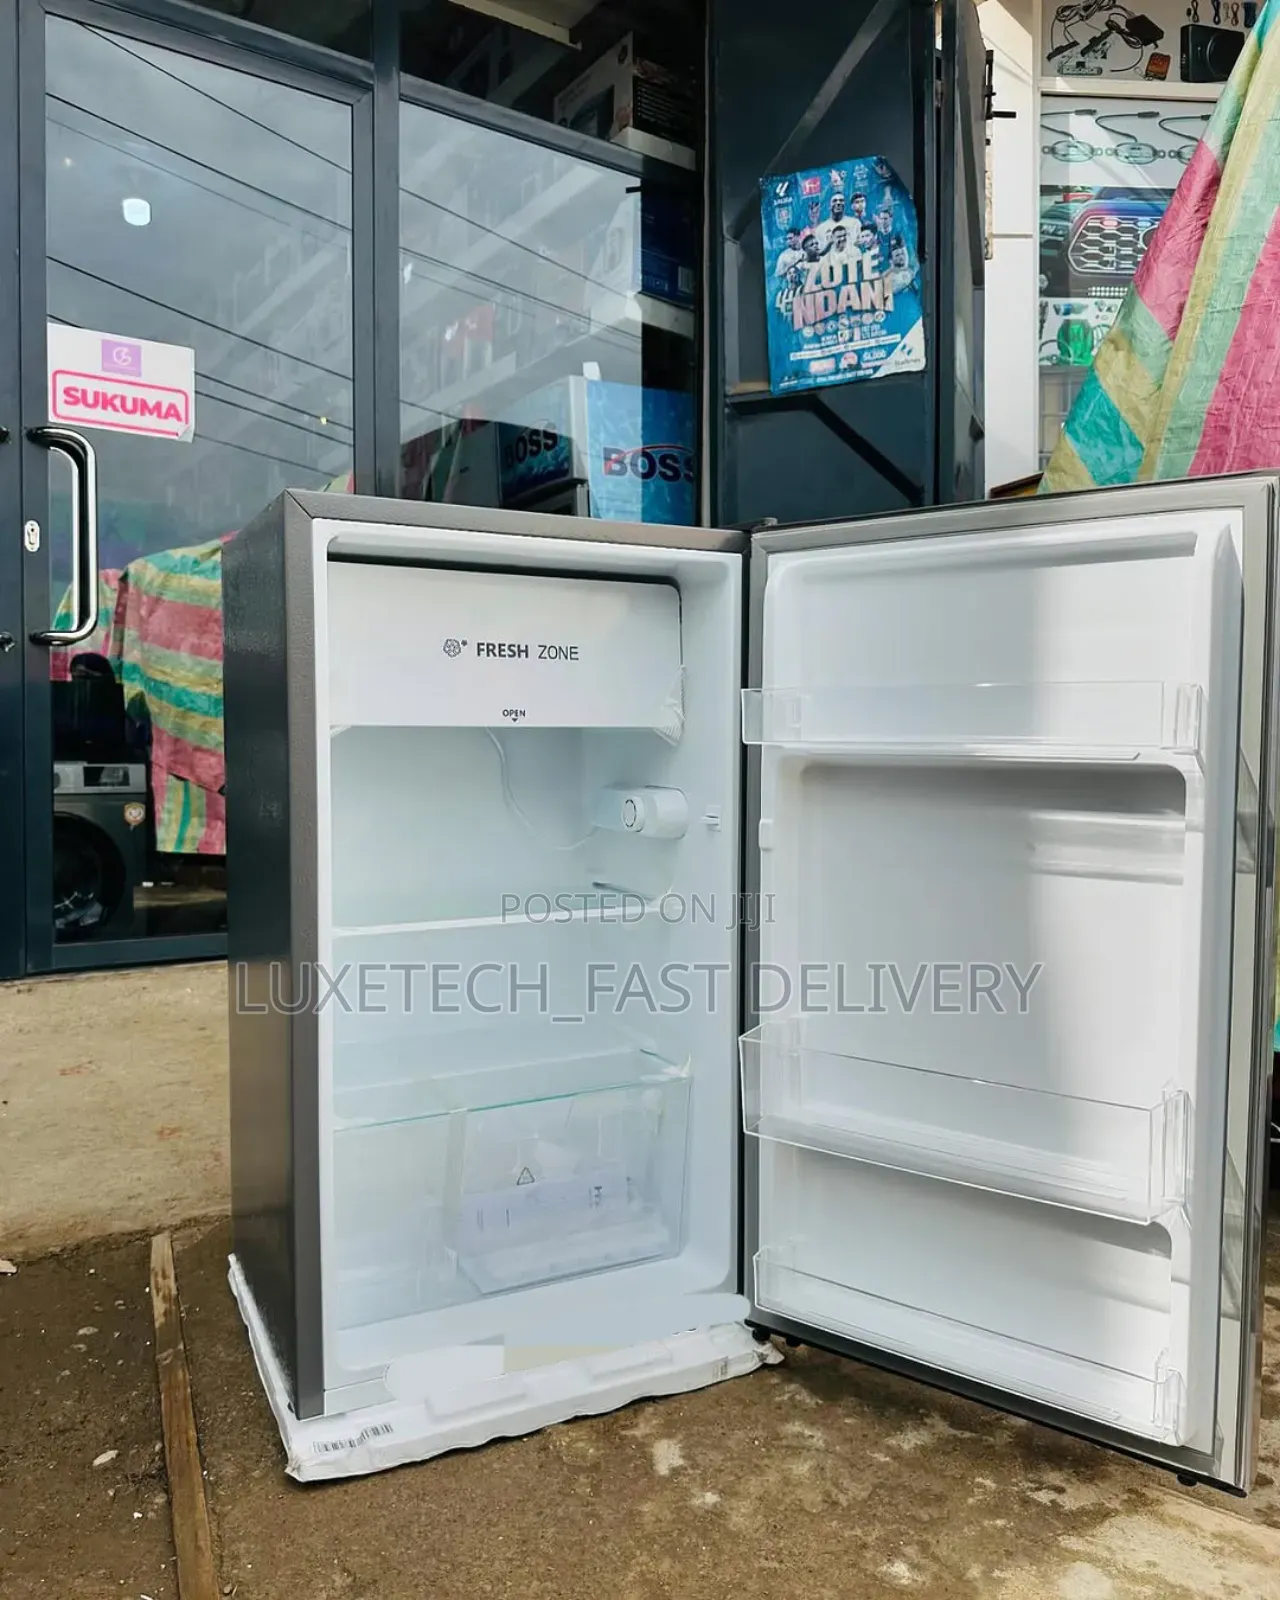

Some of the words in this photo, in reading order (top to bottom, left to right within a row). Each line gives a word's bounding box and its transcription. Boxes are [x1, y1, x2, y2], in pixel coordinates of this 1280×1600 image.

[804, 247, 881, 294] ZOTE
[63, 386, 183, 422] SUKUMA
[504, 422, 558, 469] BOSS
[476, 642, 529, 659] FRESH
[538, 645, 579, 661] ZONE
[502, 709, 526, 718] OPEN
